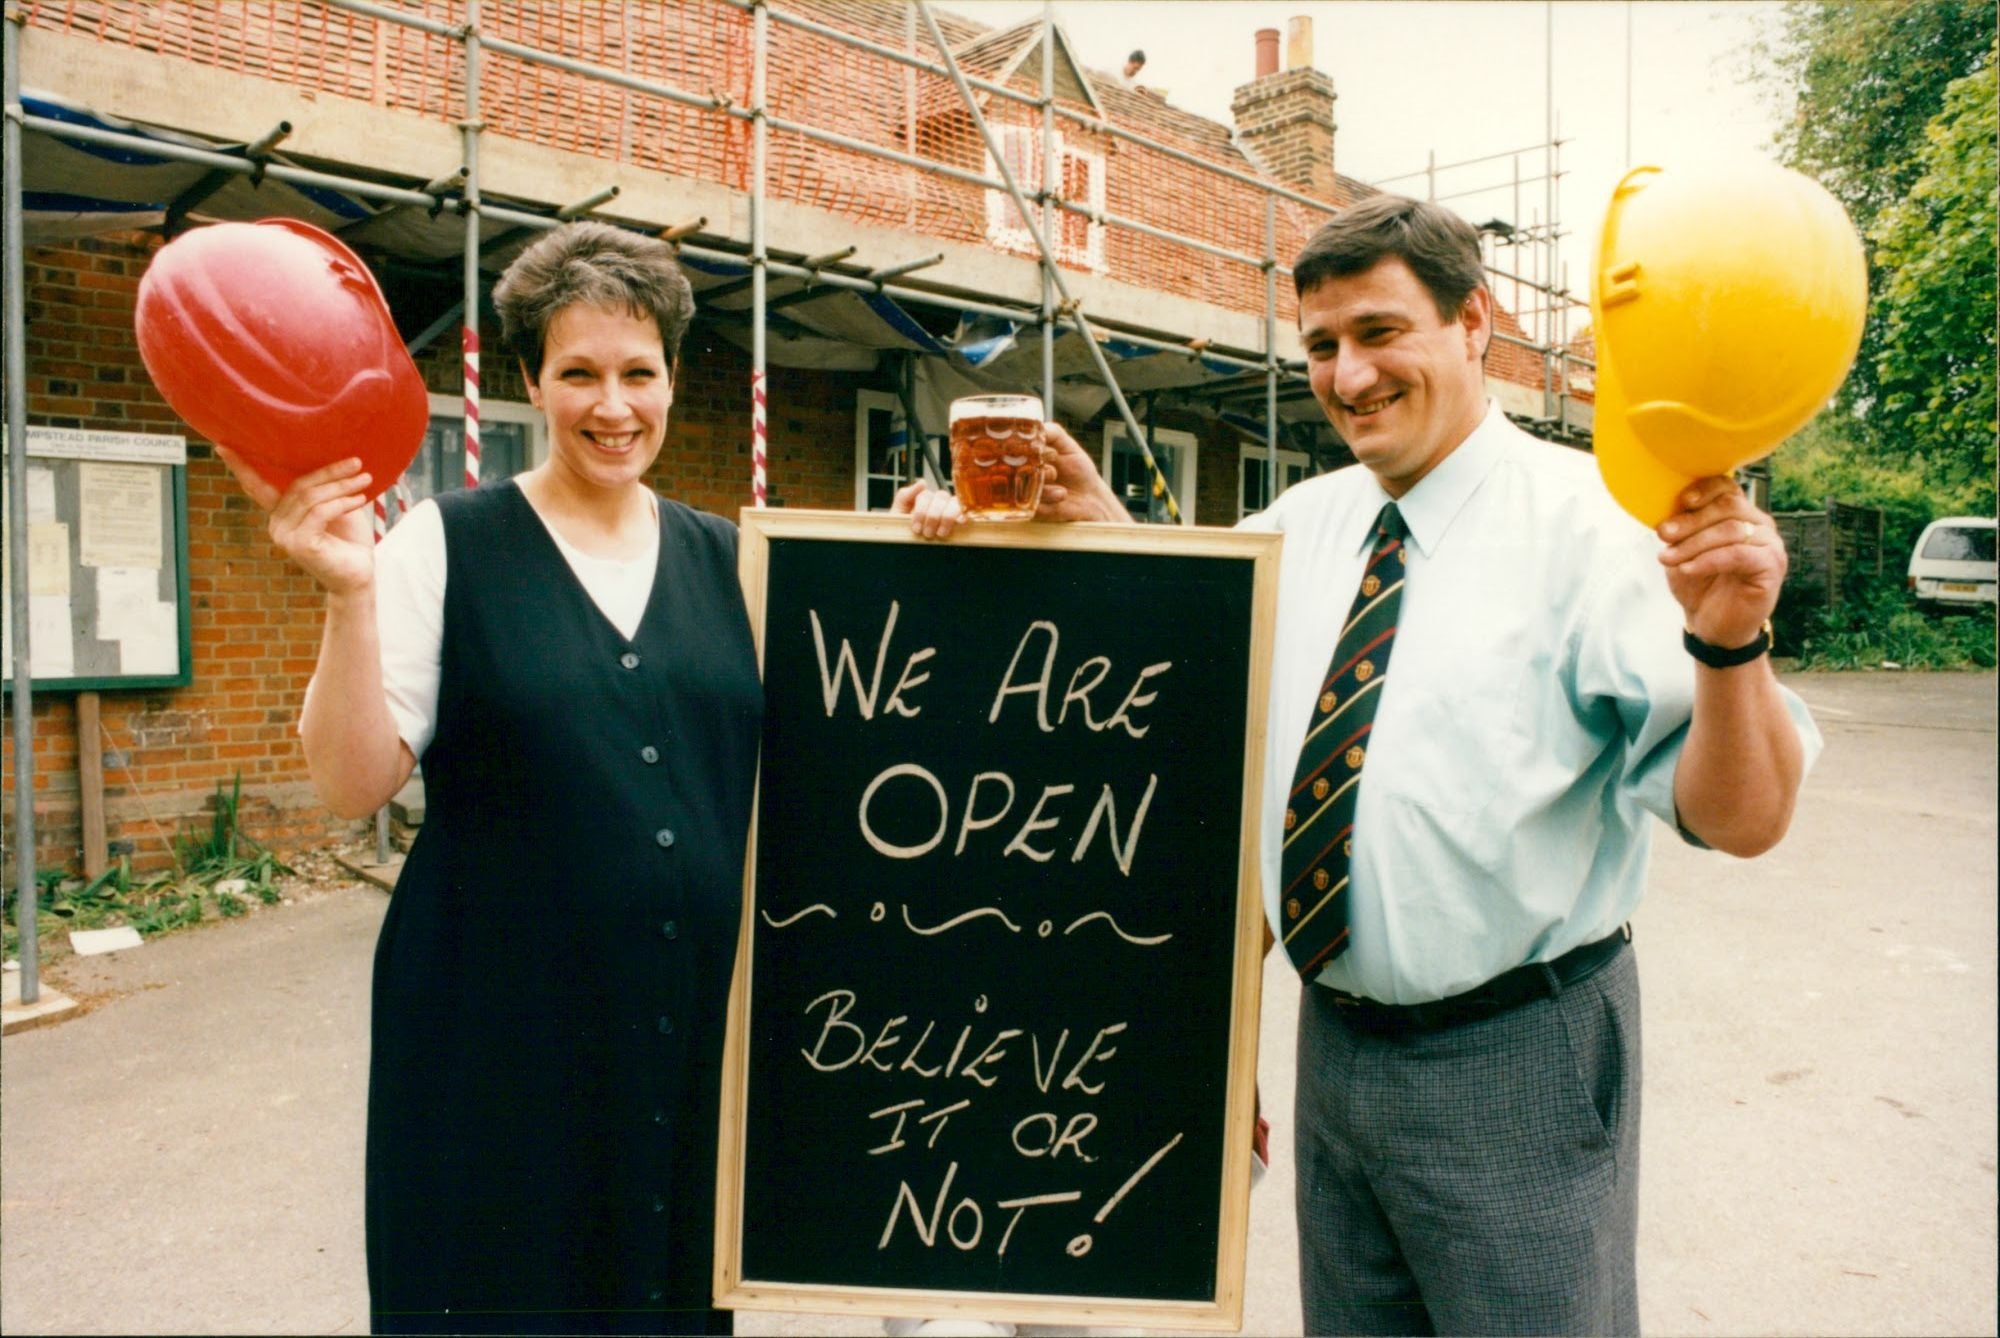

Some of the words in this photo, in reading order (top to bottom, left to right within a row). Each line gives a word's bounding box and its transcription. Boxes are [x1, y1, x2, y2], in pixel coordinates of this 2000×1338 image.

[25, 429, 84, 441] MPSTEAD
[87, 433, 129, 445] PARISH
[133, 436, 183, 447] COUNCIL
[809, 600, 936, 720] WE
[989, 620, 1172, 738] ARE
[859, 763, 1158, 876] OPEN
[801, 989, 1127, 1095] BELIEVE
[868, 1099, 970, 1155] IT
[1012, 1112, 1098, 1163] OR
[878, 1132, 1183, 1257] NOT!
